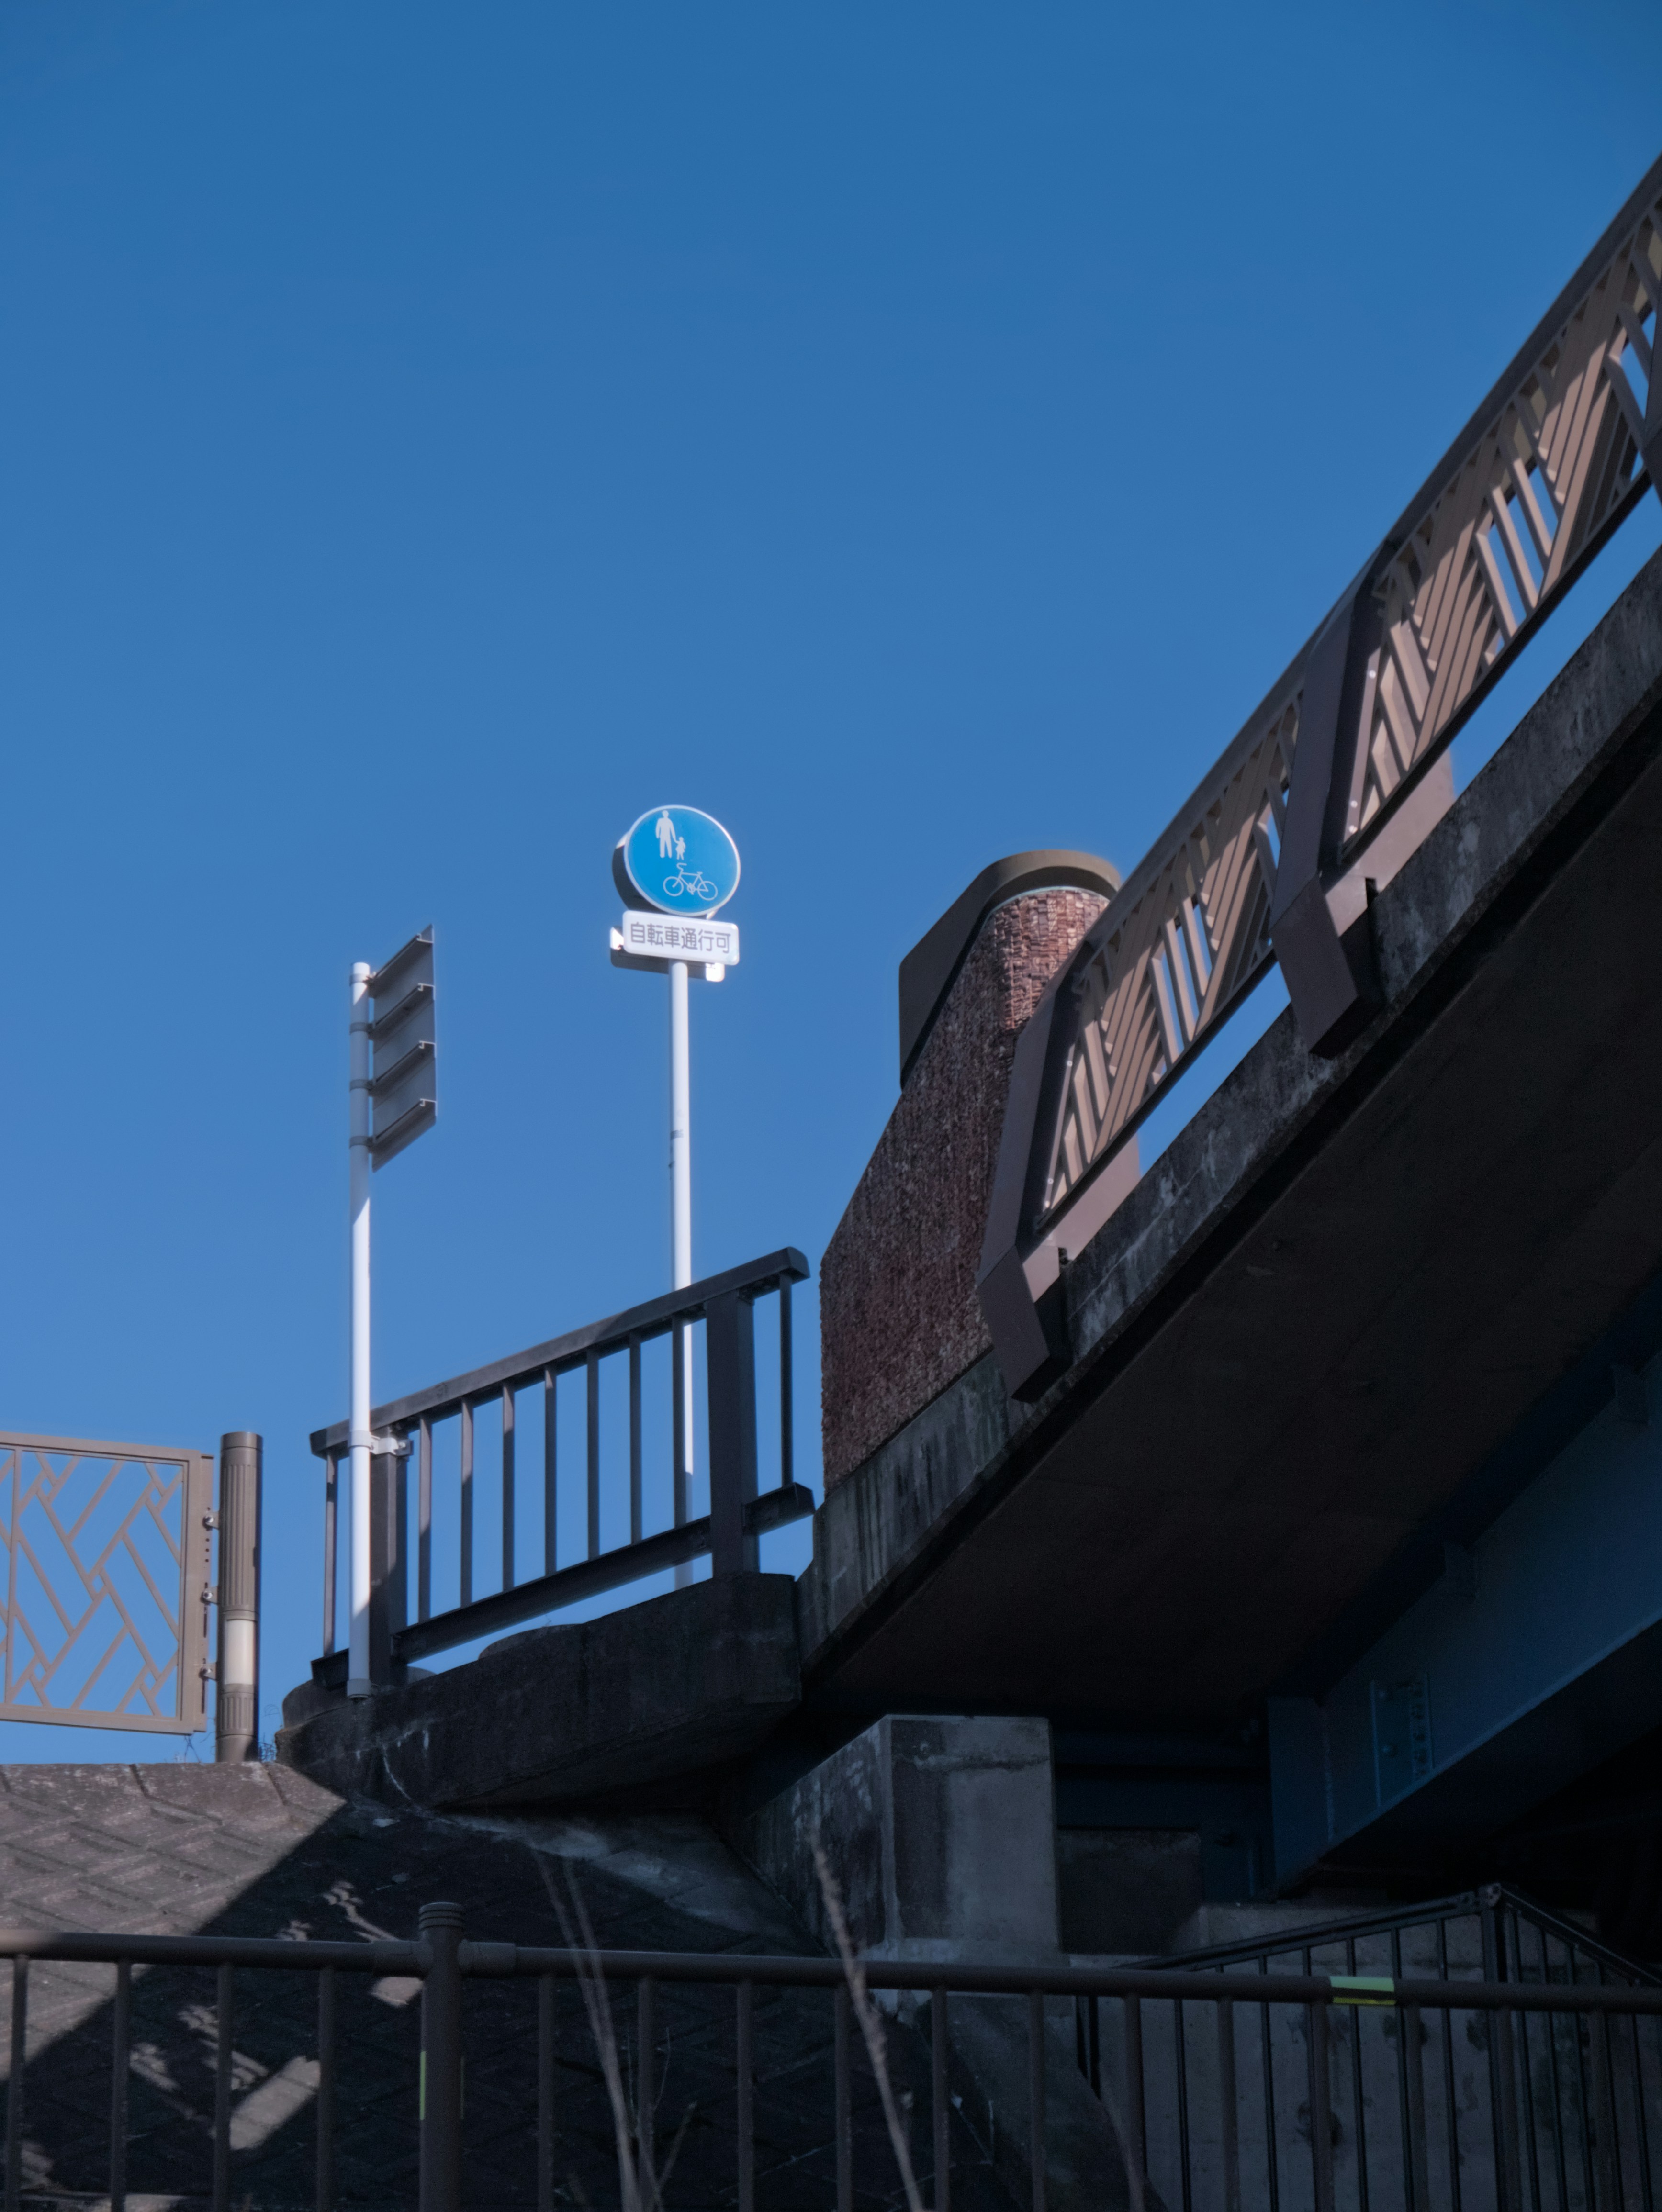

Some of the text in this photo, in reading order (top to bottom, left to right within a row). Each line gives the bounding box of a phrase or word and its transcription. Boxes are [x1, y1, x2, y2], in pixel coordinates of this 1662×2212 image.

[630, 921, 731, 954] 自転車通行可
